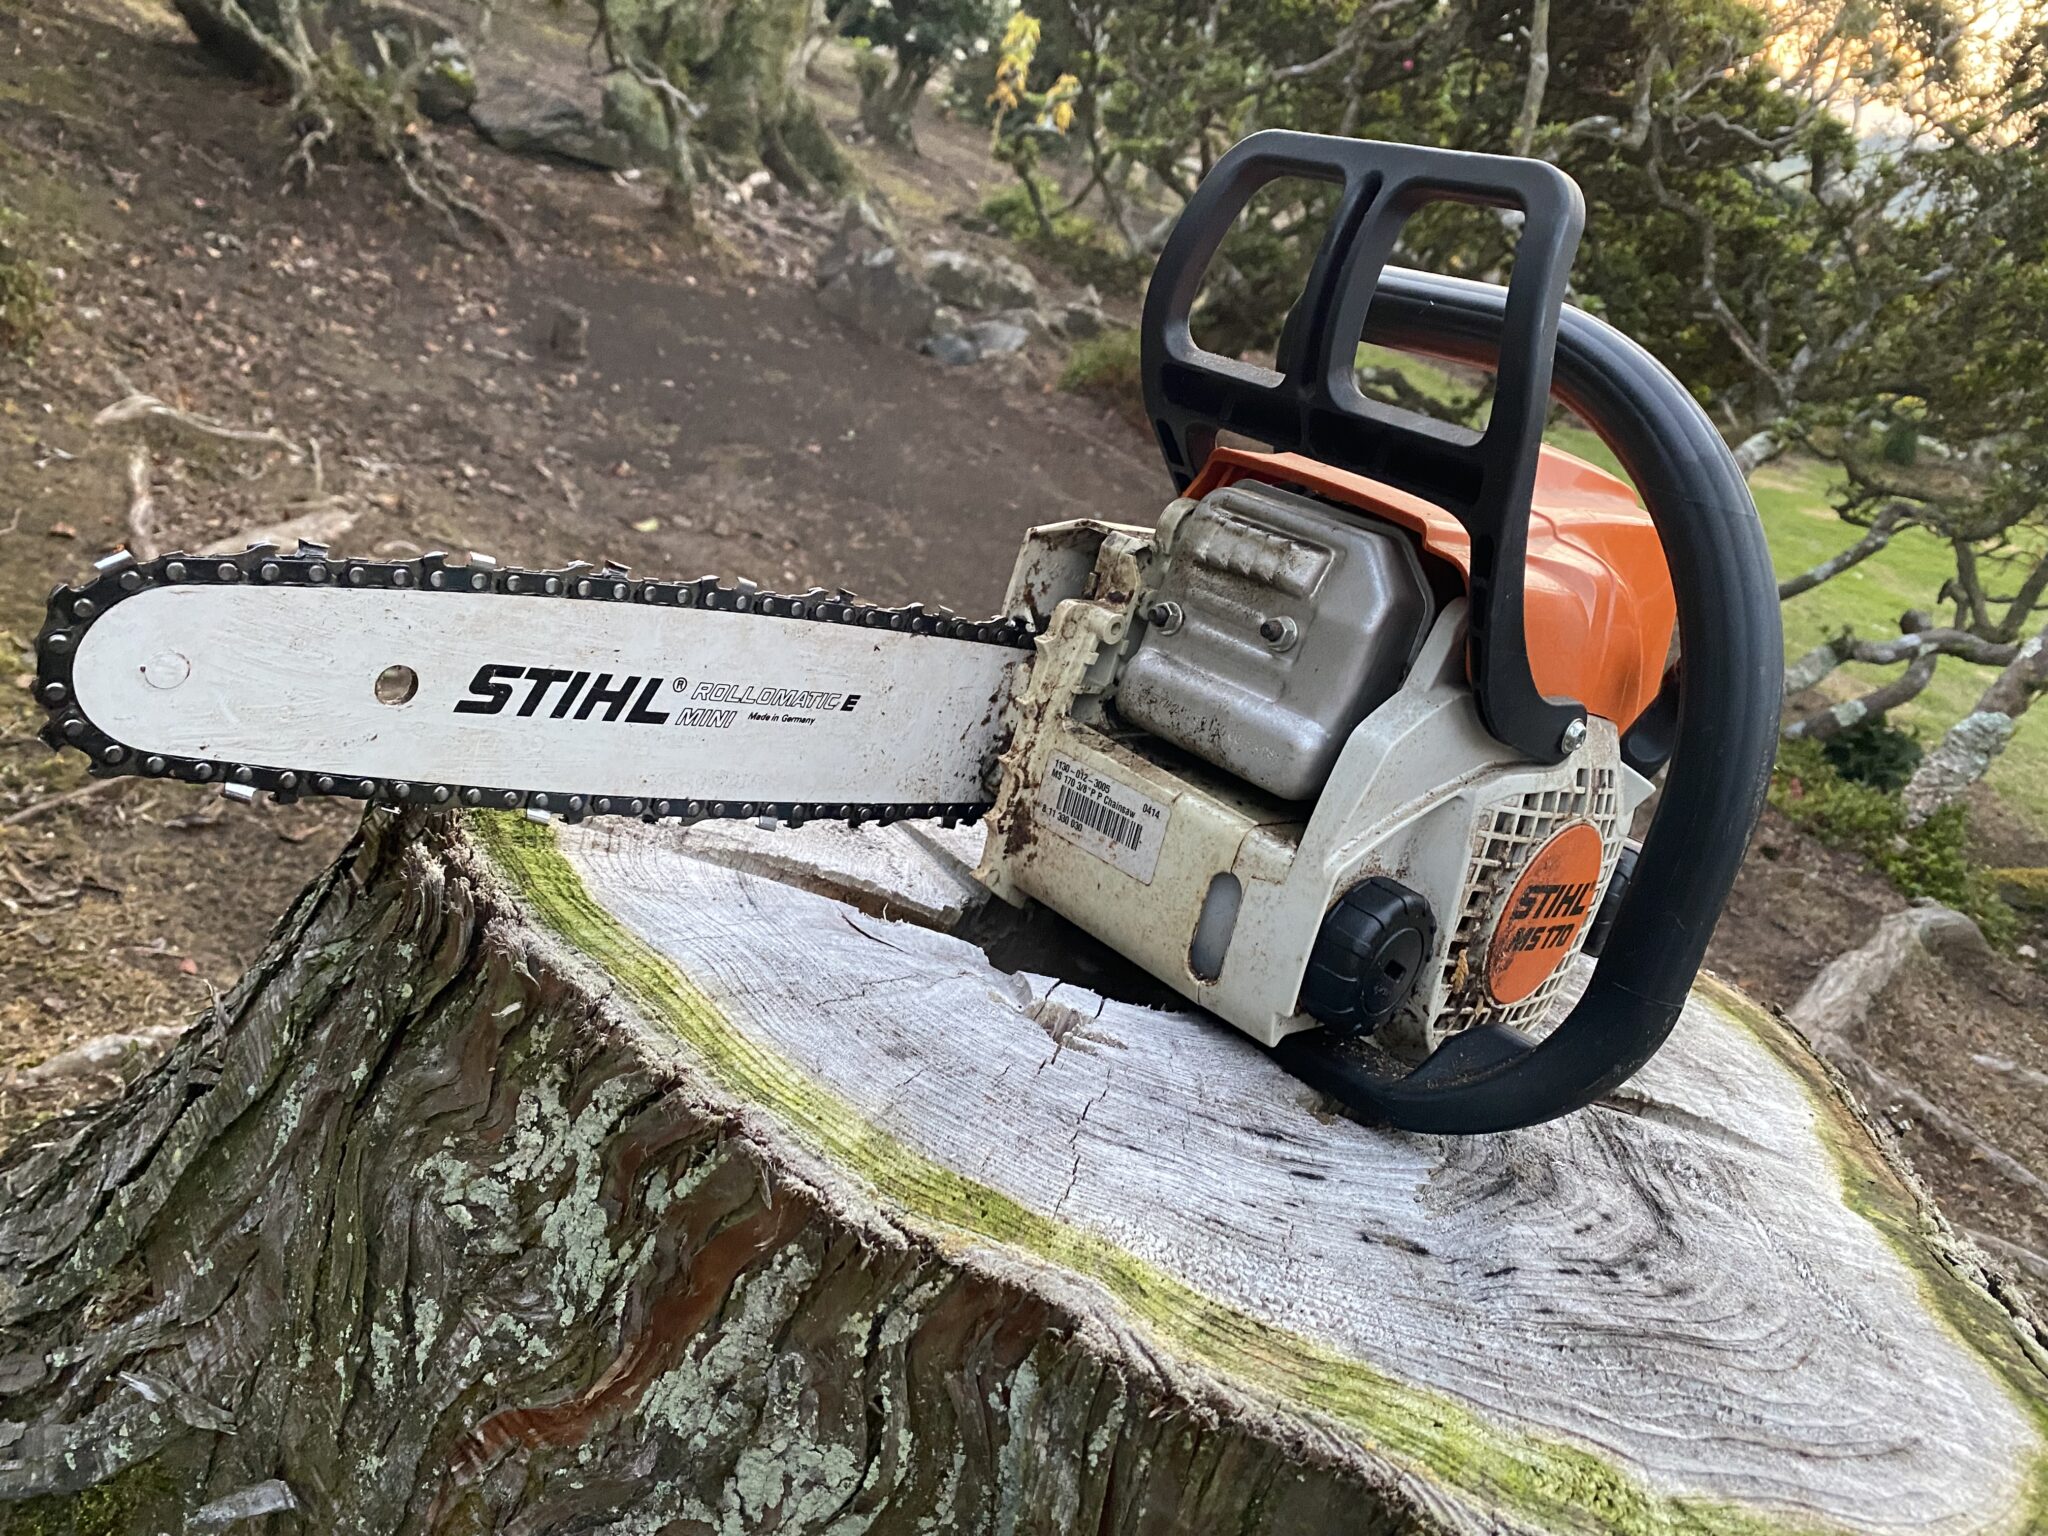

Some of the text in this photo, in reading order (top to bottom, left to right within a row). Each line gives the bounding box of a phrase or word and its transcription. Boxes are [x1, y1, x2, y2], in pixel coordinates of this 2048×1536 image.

[675, 708, 737, 728] MINI
[748, 712, 816, 725] Made in Germany
[1052, 768, 1063, 781] MS
[1064, 775, 1076, 788] 170
[1103, 796, 1136, 819] Chainsaw
[1142, 803, 1161, 820] 0414
[1057, 813, 1069, 825] 330
[1070, 819, 1083, 832] 030
[1540, 923, 1575, 949] 170
